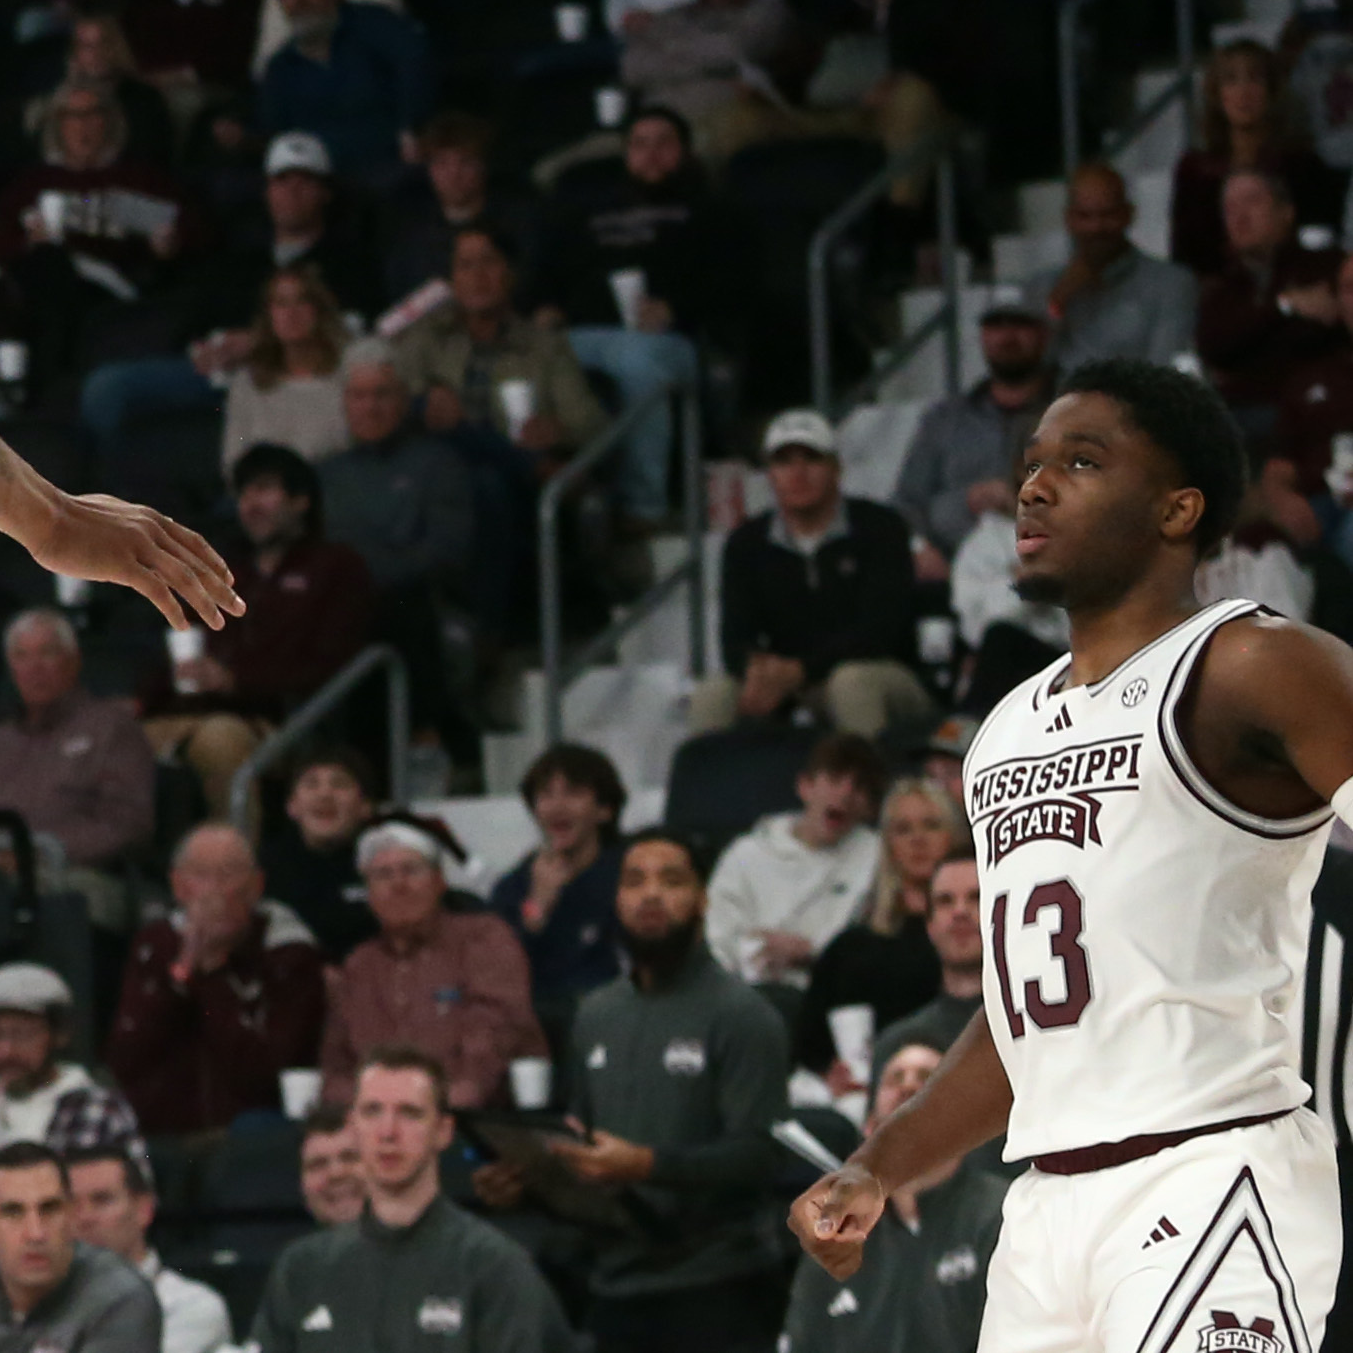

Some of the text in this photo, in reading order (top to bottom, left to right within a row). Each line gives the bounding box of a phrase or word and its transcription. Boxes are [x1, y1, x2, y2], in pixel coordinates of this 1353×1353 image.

[970, 742, 1143, 820] MISSISSIPPI
[998, 804, 1077, 854] STATE
[991, 876, 1094, 1041] 13
[1214, 1330, 1273, 1353] STATE
